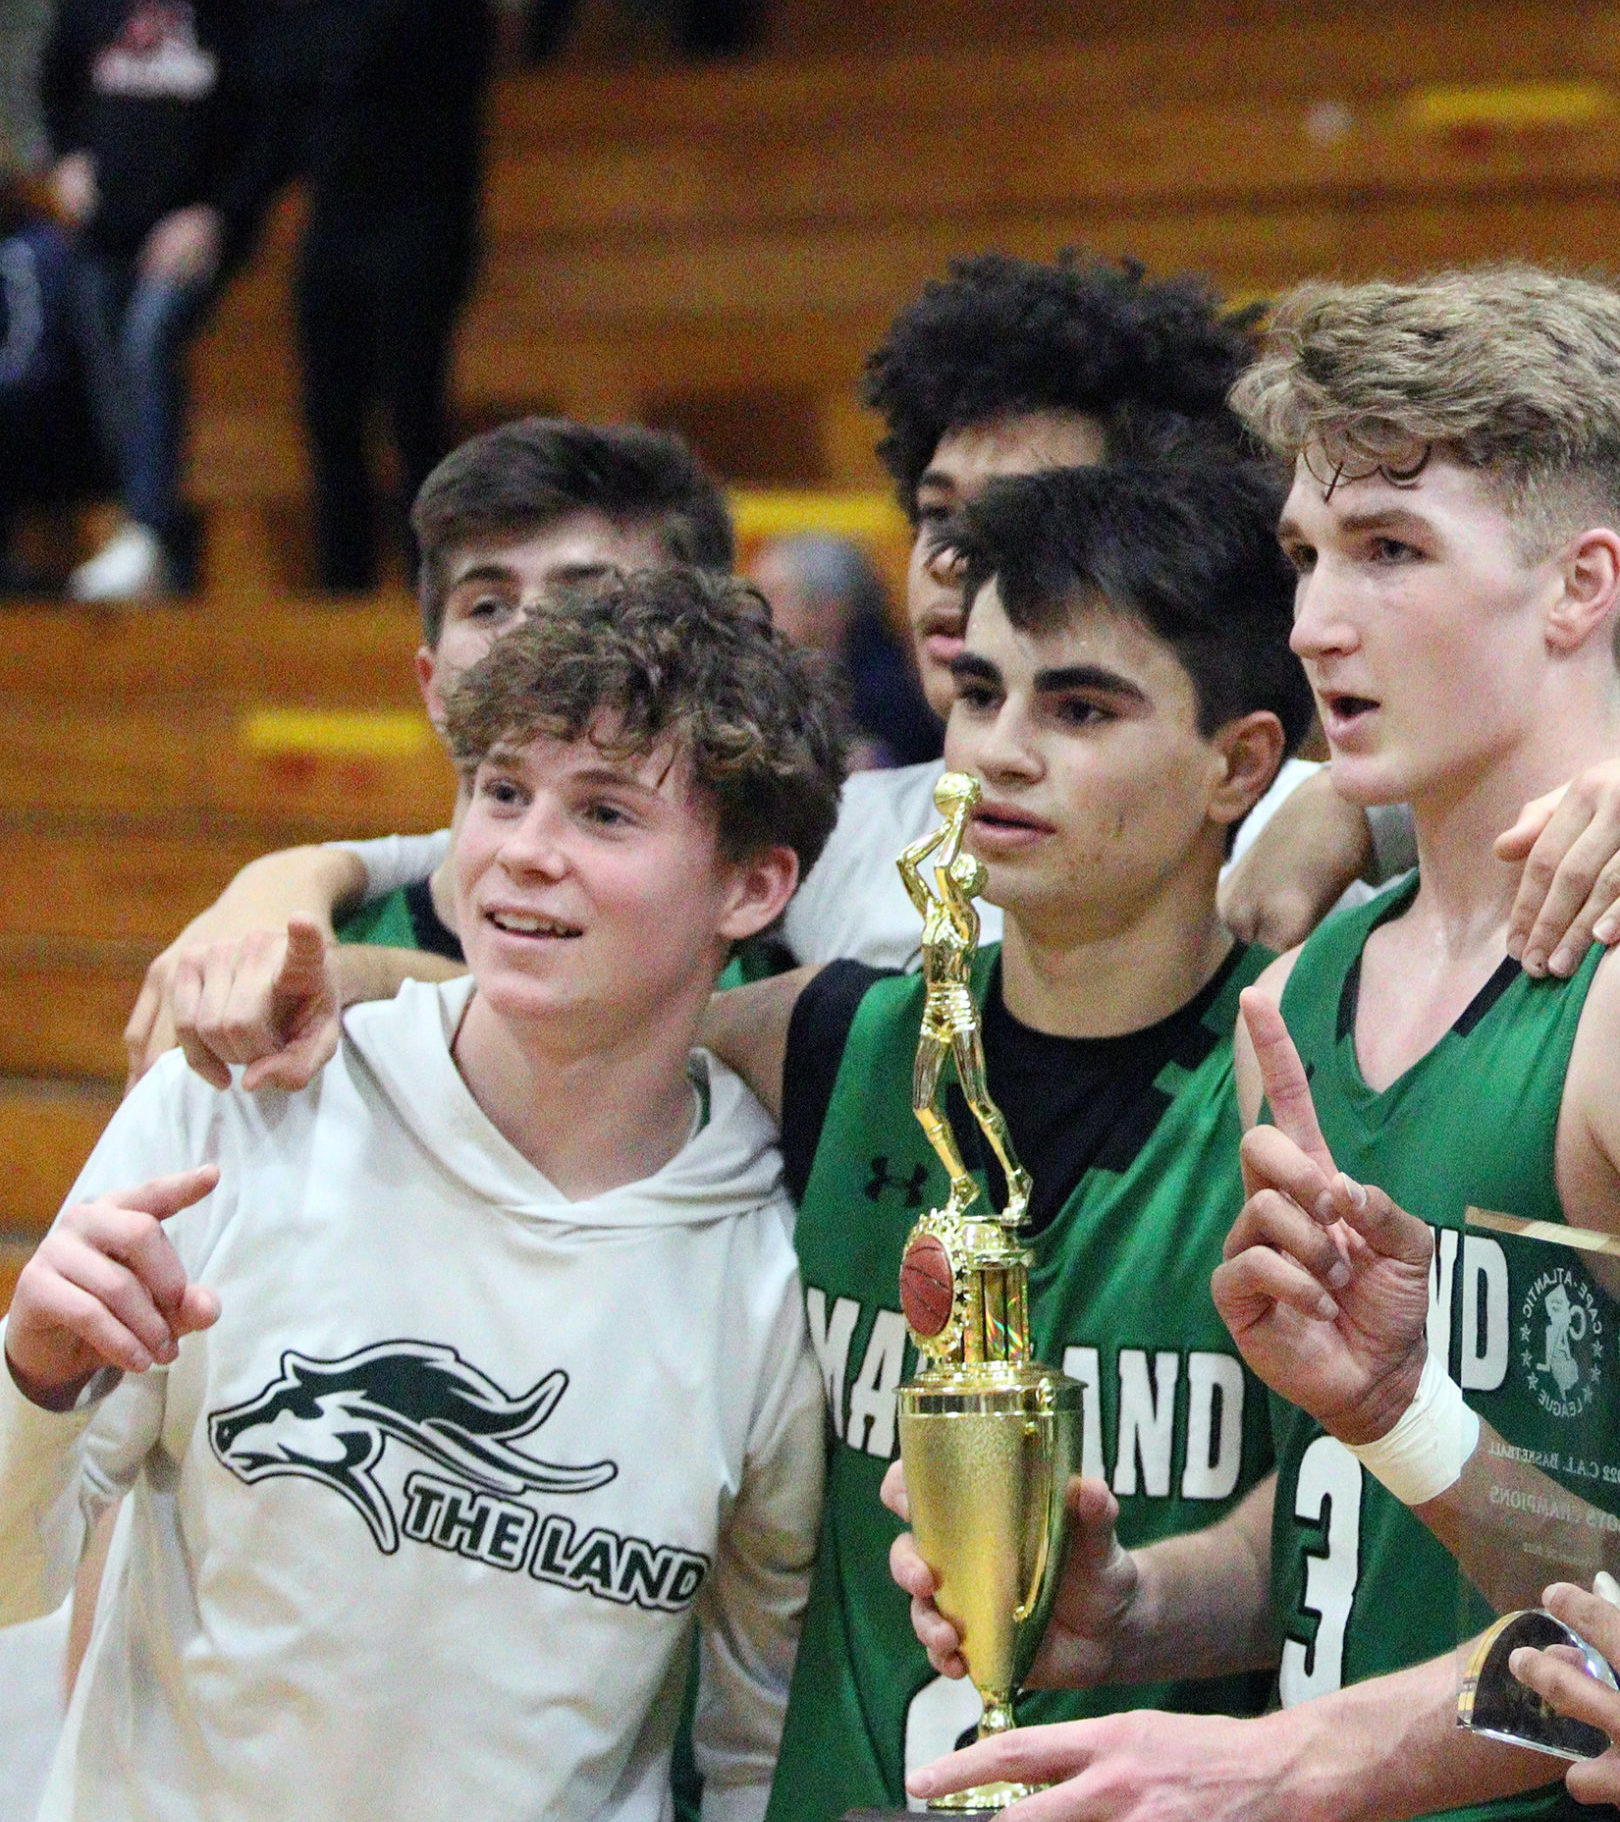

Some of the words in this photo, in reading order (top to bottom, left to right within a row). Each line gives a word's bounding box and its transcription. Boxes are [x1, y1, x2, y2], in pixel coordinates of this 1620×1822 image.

[805, 1288, 1246, 1500] MAAND
[403, 1474, 532, 1571] THE
[533, 1516, 711, 1612] LAND
[1280, 1436, 1363, 1710] 3
